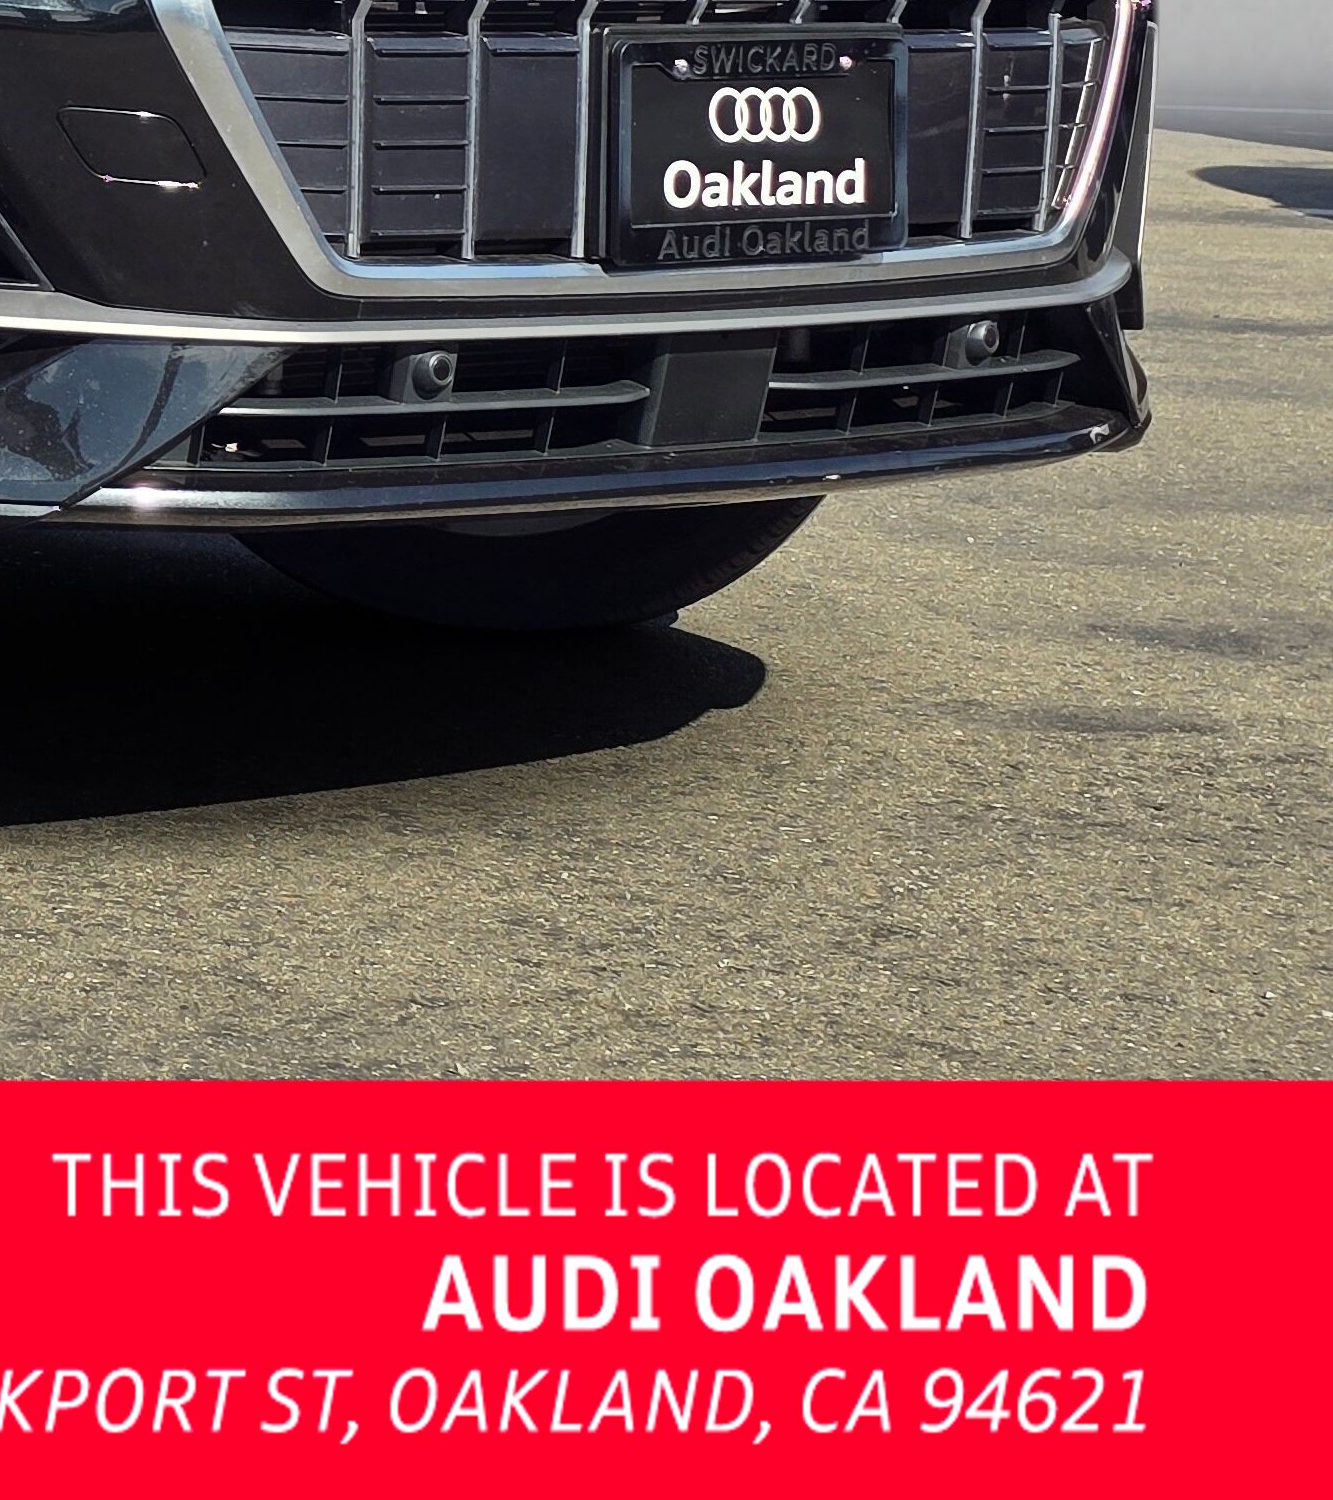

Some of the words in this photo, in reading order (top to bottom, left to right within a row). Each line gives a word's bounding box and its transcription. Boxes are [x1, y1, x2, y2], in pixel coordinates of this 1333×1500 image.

[692, 42, 837, 76] SWICKARD
[663, 157, 867, 209] Oakland
[657, 225, 731, 261] Audi
[741, 220, 871, 256] Oakland
